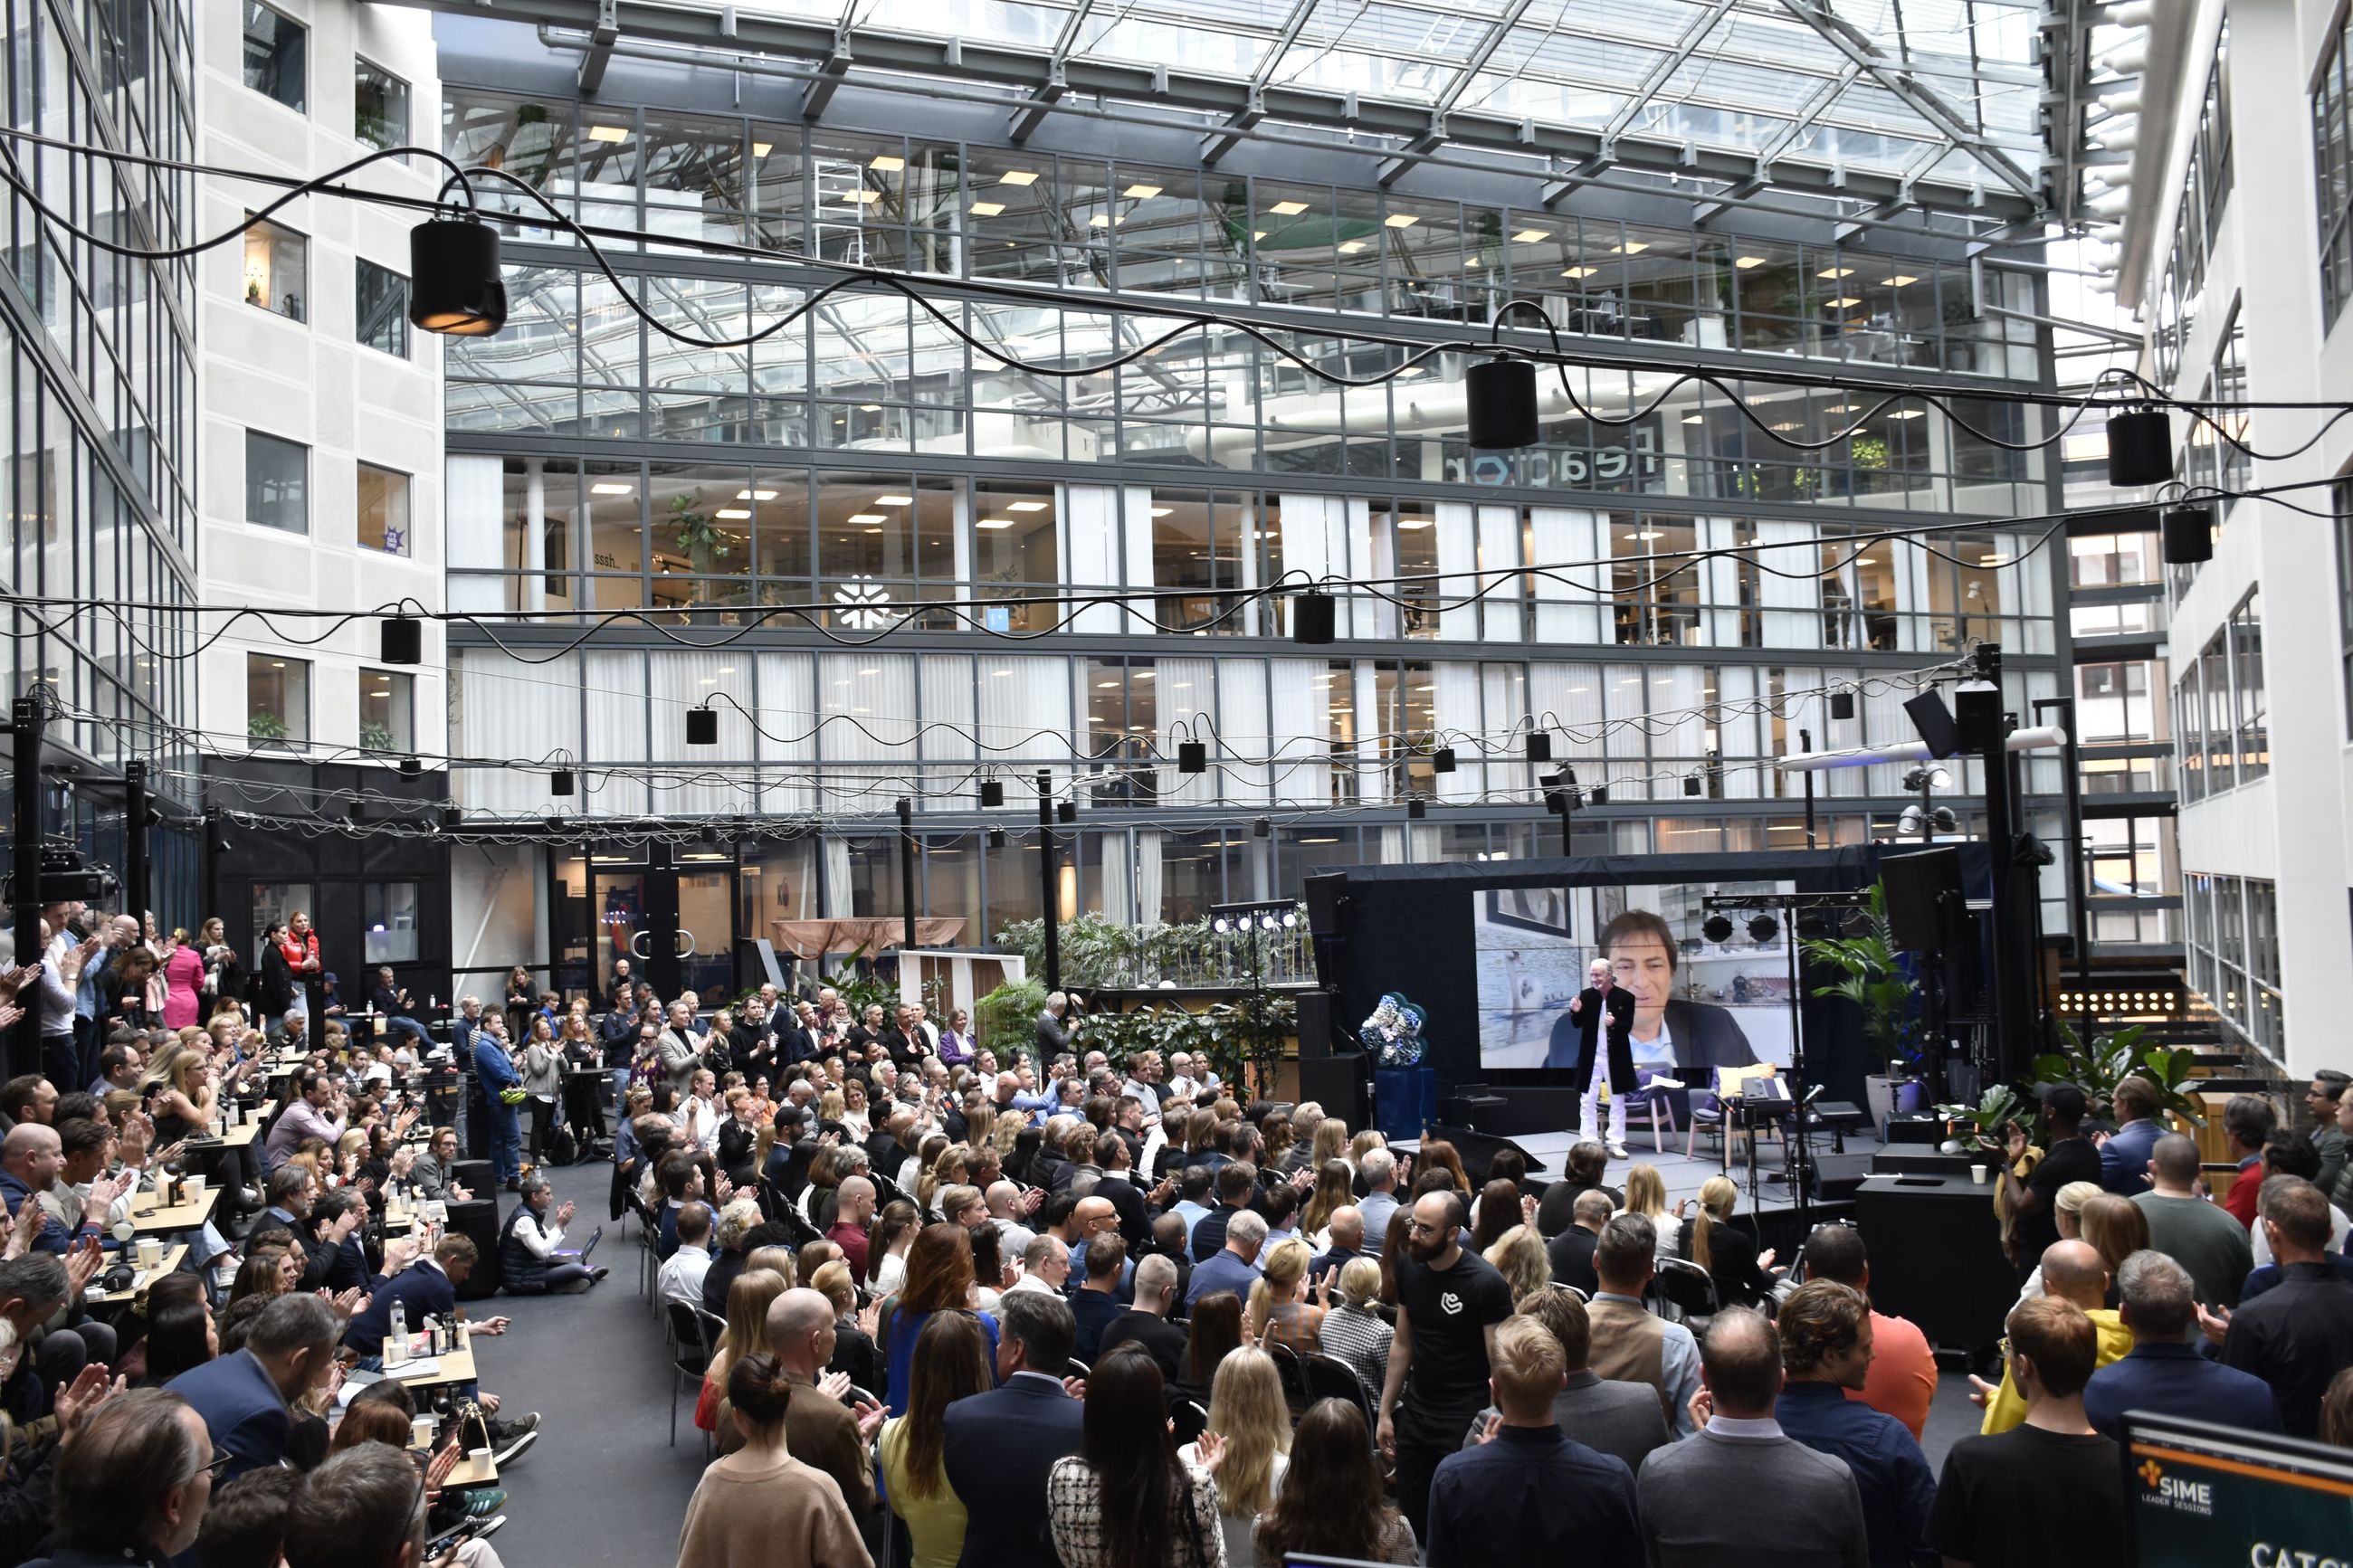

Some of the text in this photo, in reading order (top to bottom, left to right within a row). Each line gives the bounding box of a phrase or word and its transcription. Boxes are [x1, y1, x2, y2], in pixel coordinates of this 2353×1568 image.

[2159, 1476, 2211, 1505] SIME
[2141, 1493, 2212, 1516] LEADER SESSIONS
